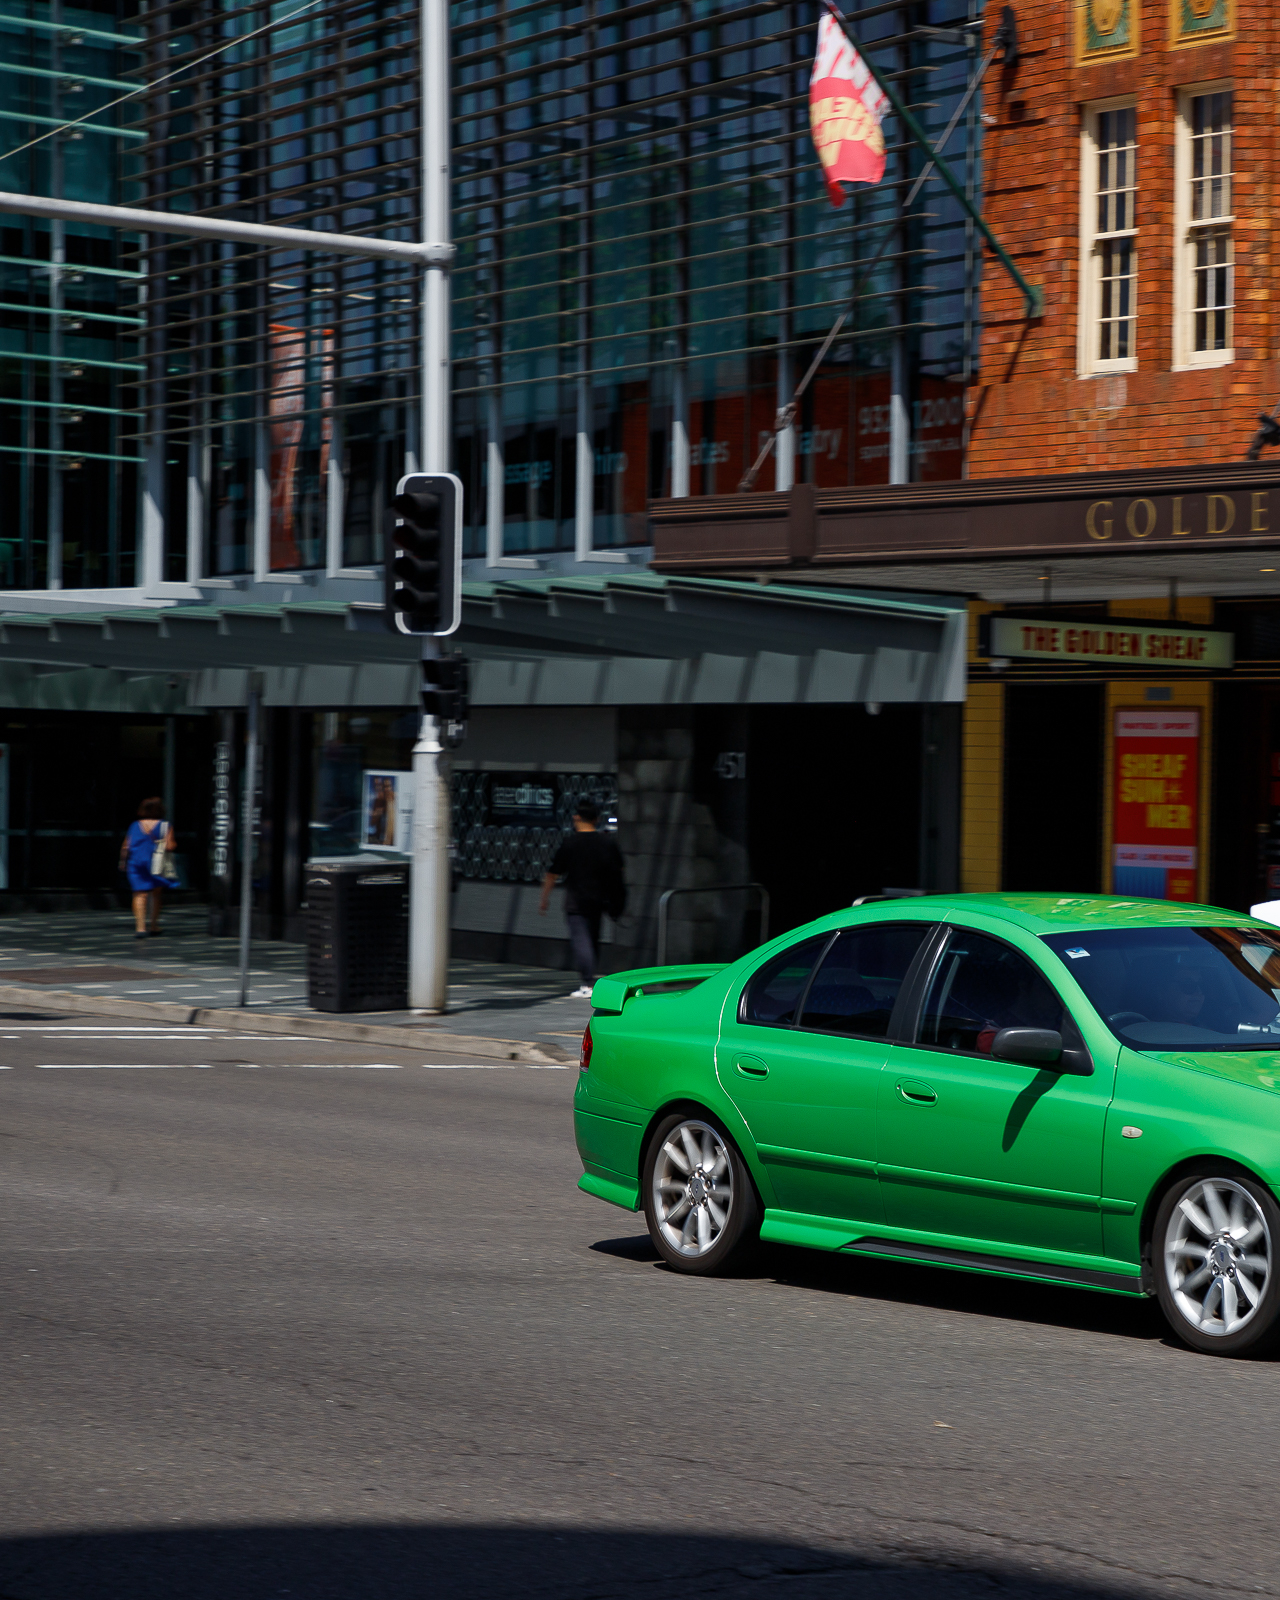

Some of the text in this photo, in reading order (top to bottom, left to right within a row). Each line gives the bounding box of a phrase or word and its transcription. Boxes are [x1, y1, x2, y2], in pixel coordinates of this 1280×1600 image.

[1021, 626, 1208, 660] THE GOLDEN SHEAF
[1120, 753, 1188, 779] SHEAF
[1146, 803, 1192, 830] MER
